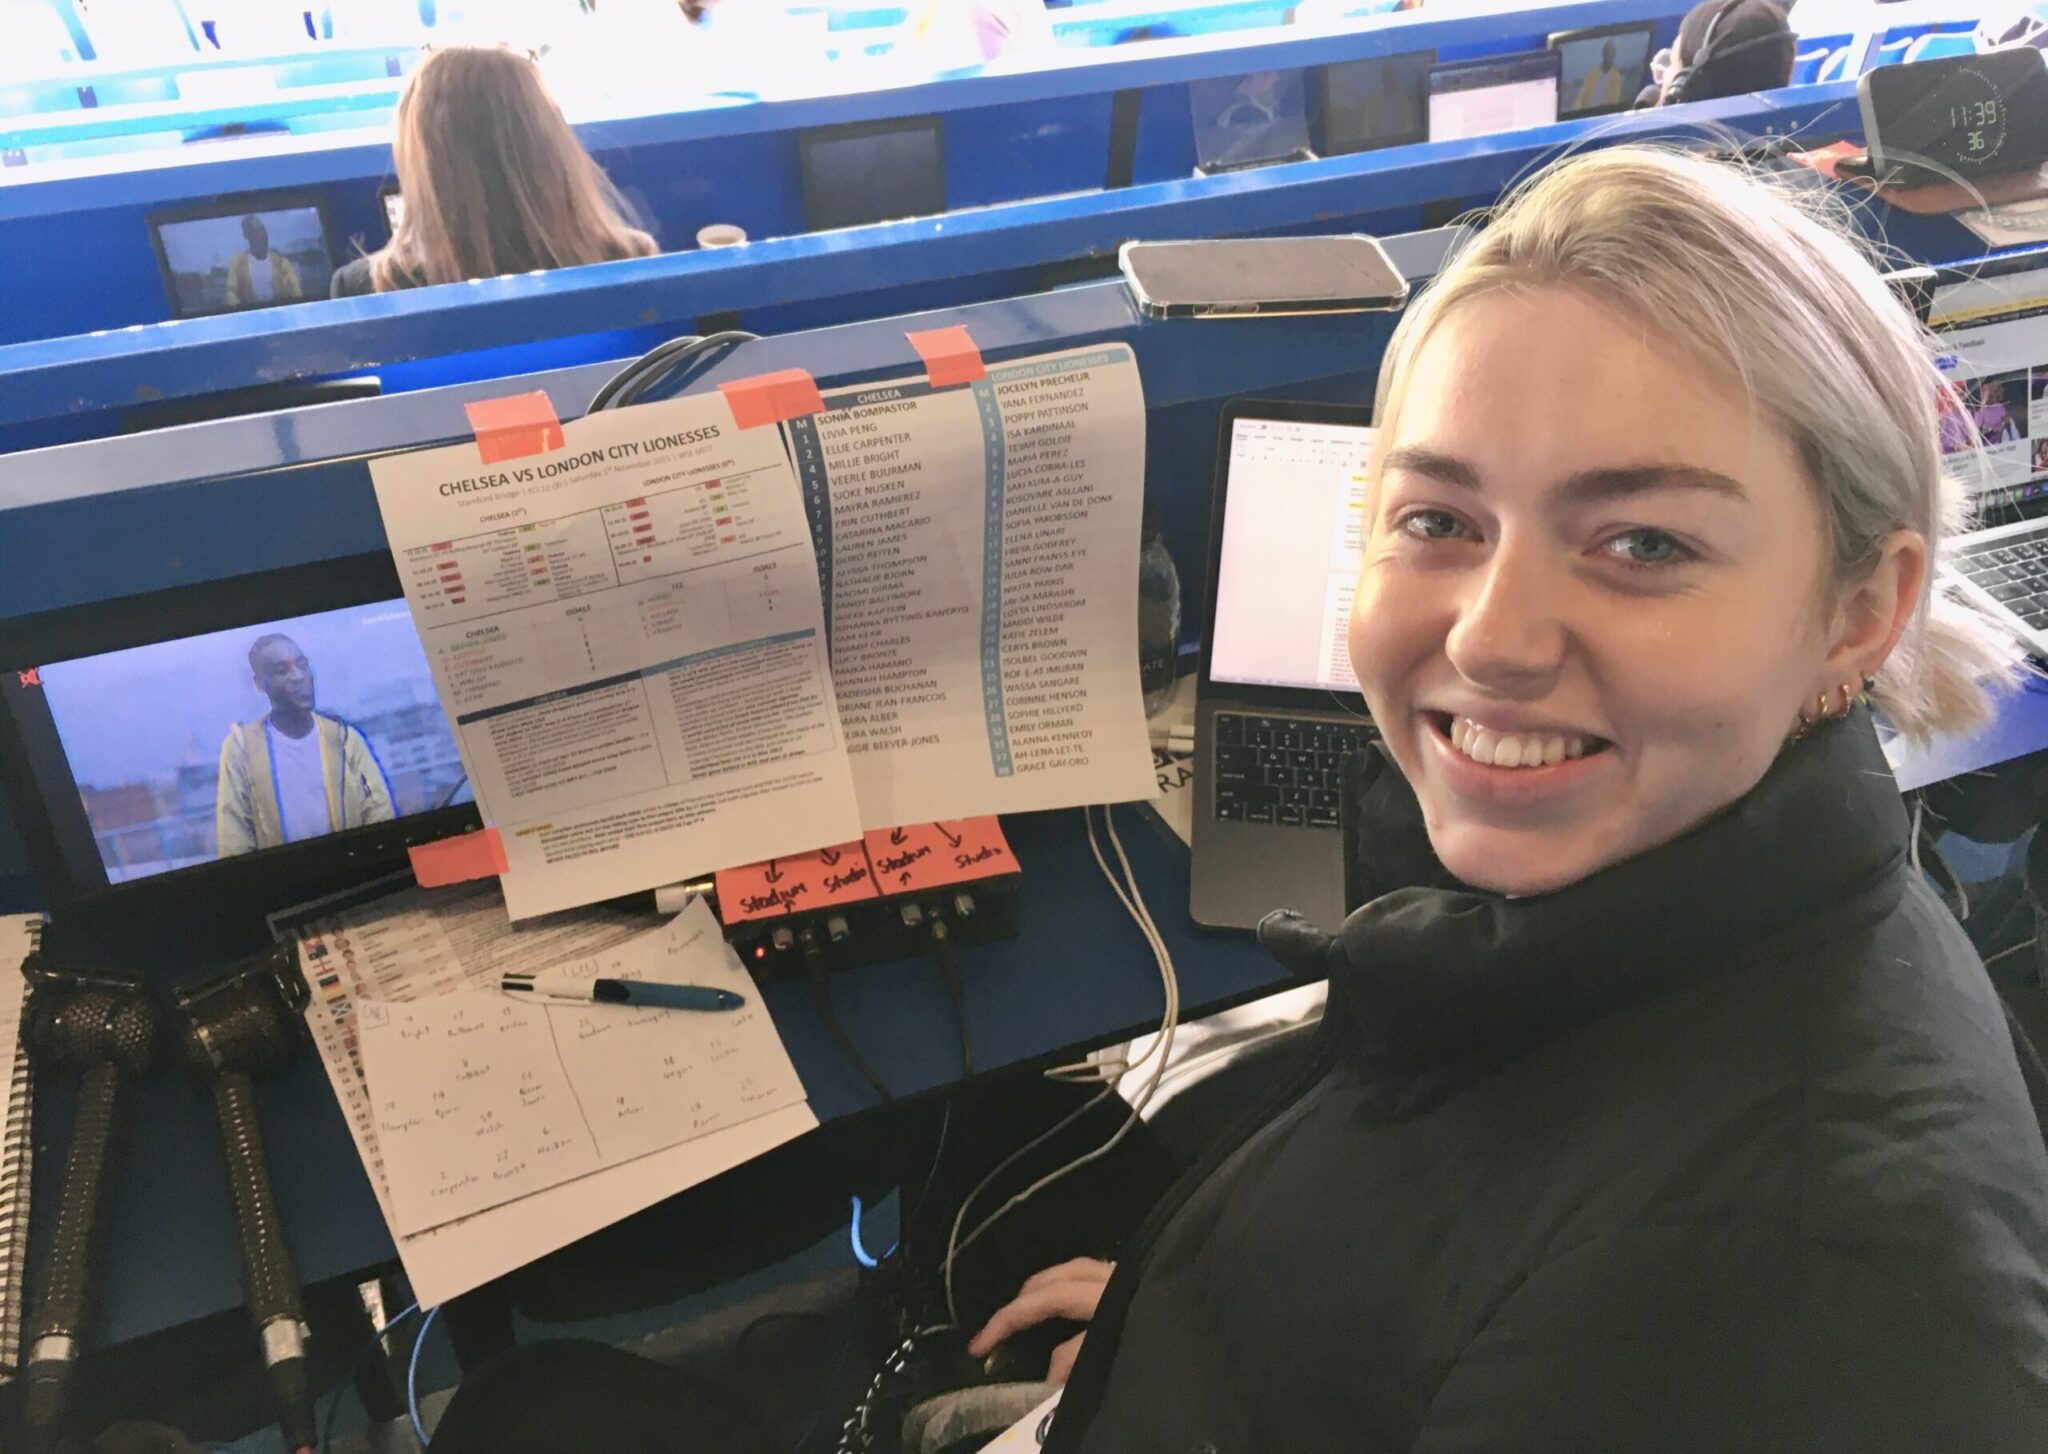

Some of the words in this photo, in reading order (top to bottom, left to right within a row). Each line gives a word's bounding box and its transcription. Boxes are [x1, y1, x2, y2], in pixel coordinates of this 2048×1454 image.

[1950, 100, 1997, 129] 11:39
[1967, 130, 1985, 151] 36
[992, 367, 1032, 381] LONDON
[1035, 362, 1058, 374] CITY
[997, 379, 1039, 395] JOCELYN
[1040, 371, 1090, 387] PRECHEUR
[856, 390, 902, 404] CHELSEA
[1001, 398, 1028, 410] YANA
[1029, 387, 1085, 405] FERNANDEZ
[796, 419, 808, 431] M
[817, 410, 851, 426] SONIA
[853, 401, 917, 419] BOMPASTOR
[1004, 411, 1035, 425] POPPY
[1037, 402, 1089, 420] PATTINSON
[821, 427, 848, 441] LIVIA
[850, 422, 878, 435] PENG
[1007, 428, 1022, 440] ISA
[1024, 419, 1077, 436] KARDINAAL
[805, 449, 815, 460] 2
[824, 441, 851, 456] ELLIE
[853, 431, 912, 451] CARPENTER
[1037, 434, 1073, 448] GOLDIE
[438, 472, 511, 498] CHELSEA
[512, 467, 535, 484] VS
[536, 448, 606, 480] LONDON
[607, 441, 640, 461] CITY
[642, 424, 721, 454] LIONESSES
[808, 463, 817, 475] 4
[828, 456, 861, 471] MILLIE
[863, 449, 901, 465] BRIGHT
[1007, 453, 1038, 467] MARIA
[1039, 448, 1070, 460] PEREZ
[811, 479, 820, 490] 5
[830, 471, 867, 486] VEERLE
[869, 461, 922, 480] BUURMAN
[1006, 466, 1033, 480] LUCIA
[813, 494, 822, 505] 6
[832, 488, 862, 502] SJOKE
[864, 479, 905, 495] NUSKEN
[1005, 489, 1054, 505] KOSOVARE
[834, 500, 870, 515] MAYRA
[1005, 502, 1048, 518] DANIELLE
[1050, 500, 1071, 511] VAN
[1072, 497, 1084, 508] DE
[835, 516, 858, 529] ERIN
[860, 507, 911, 525] CUTHBERT
[1005, 517, 1032, 530] SOFIA
[835, 526, 884, 542] CATARINA
[885, 515, 932, 532] MACARIO
[1004, 531, 1034, 545] ELENA
[835, 539, 875, 554] LAUREN
[877, 533, 908, 546] JAMES
[1032, 537, 1077, 551] GODFREY
[835, 553, 865, 566] GURO
[866, 547, 901, 561] REITEN
[836, 564, 870, 578] ALYSSA
[872, 554, 928, 570] THOMPSON
[835, 573, 882, 589] NATHALIE
[835, 587, 870, 600] NAOMI
[871, 581, 905, 593] GIRMA
[1003, 581, 1032, 595] NIKITA
[1033, 576, 1065, 589] PARRIS
[835, 598, 868, 610] SANDY
[869, 588, 922, 604] BALTIMORE
[1031, 587, 1075, 601] MARASHI
[867, 603, 907, 616] KAPTEIN
[834, 618, 881, 632] JOHANNA
[1002, 616, 1034, 629] MADDI
[1035, 612, 1065, 624] WILDE
[858, 629, 883, 640] KERR
[1002, 629, 1026, 641] KATIE
[1028, 626, 1059, 638] ZELEM
[834, 642, 869, 654] NIAMH
[870, 635, 911, 649] CHARLES
[1001, 642, 1030, 653] CERYS
[1031, 638, 1068, 649] BROWN
[860, 649, 898, 661] BRONZE
[1039, 649, 1088, 661] GOODWIN
[834, 664, 867, 676] MAIKA
[868, 658, 913, 671] HAMANO
[834, 675, 877, 688] HANNAH
[878, 668, 927, 681] HAMPTON
[1005, 681, 1037, 692] WASSA
[1038, 675, 1081, 688] SANGARE
[836, 687, 882, 700] KADEISHA
[884, 679, 938, 694] BUCHANAN
[1006, 693, 1047, 706] CORINNE
[1049, 689, 1088, 700] HENSON
[869, 711, 898, 722] ALBER
[1008, 707, 1040, 720] SOPHIE
[1042, 702, 1084, 715] HILLYERD
[843, 729, 867, 740] EIRA
[868, 725, 902, 737] WALSH
[1009, 722, 1036, 734] EMILY
[1037, 718, 1074, 730] ORMAN
[1011, 735, 1050, 746] ALANNA
[1050, 729, 1093, 741] KENNEDY
[847, 744, 870, 754] GGIE
[1016, 761, 1046, 773] GRACE
[876, 845, 932, 875] Stadium
[954, 844, 1003, 870] Studio
[739, 882, 809, 914] Stadium
[822, 860, 868, 894] Studio
